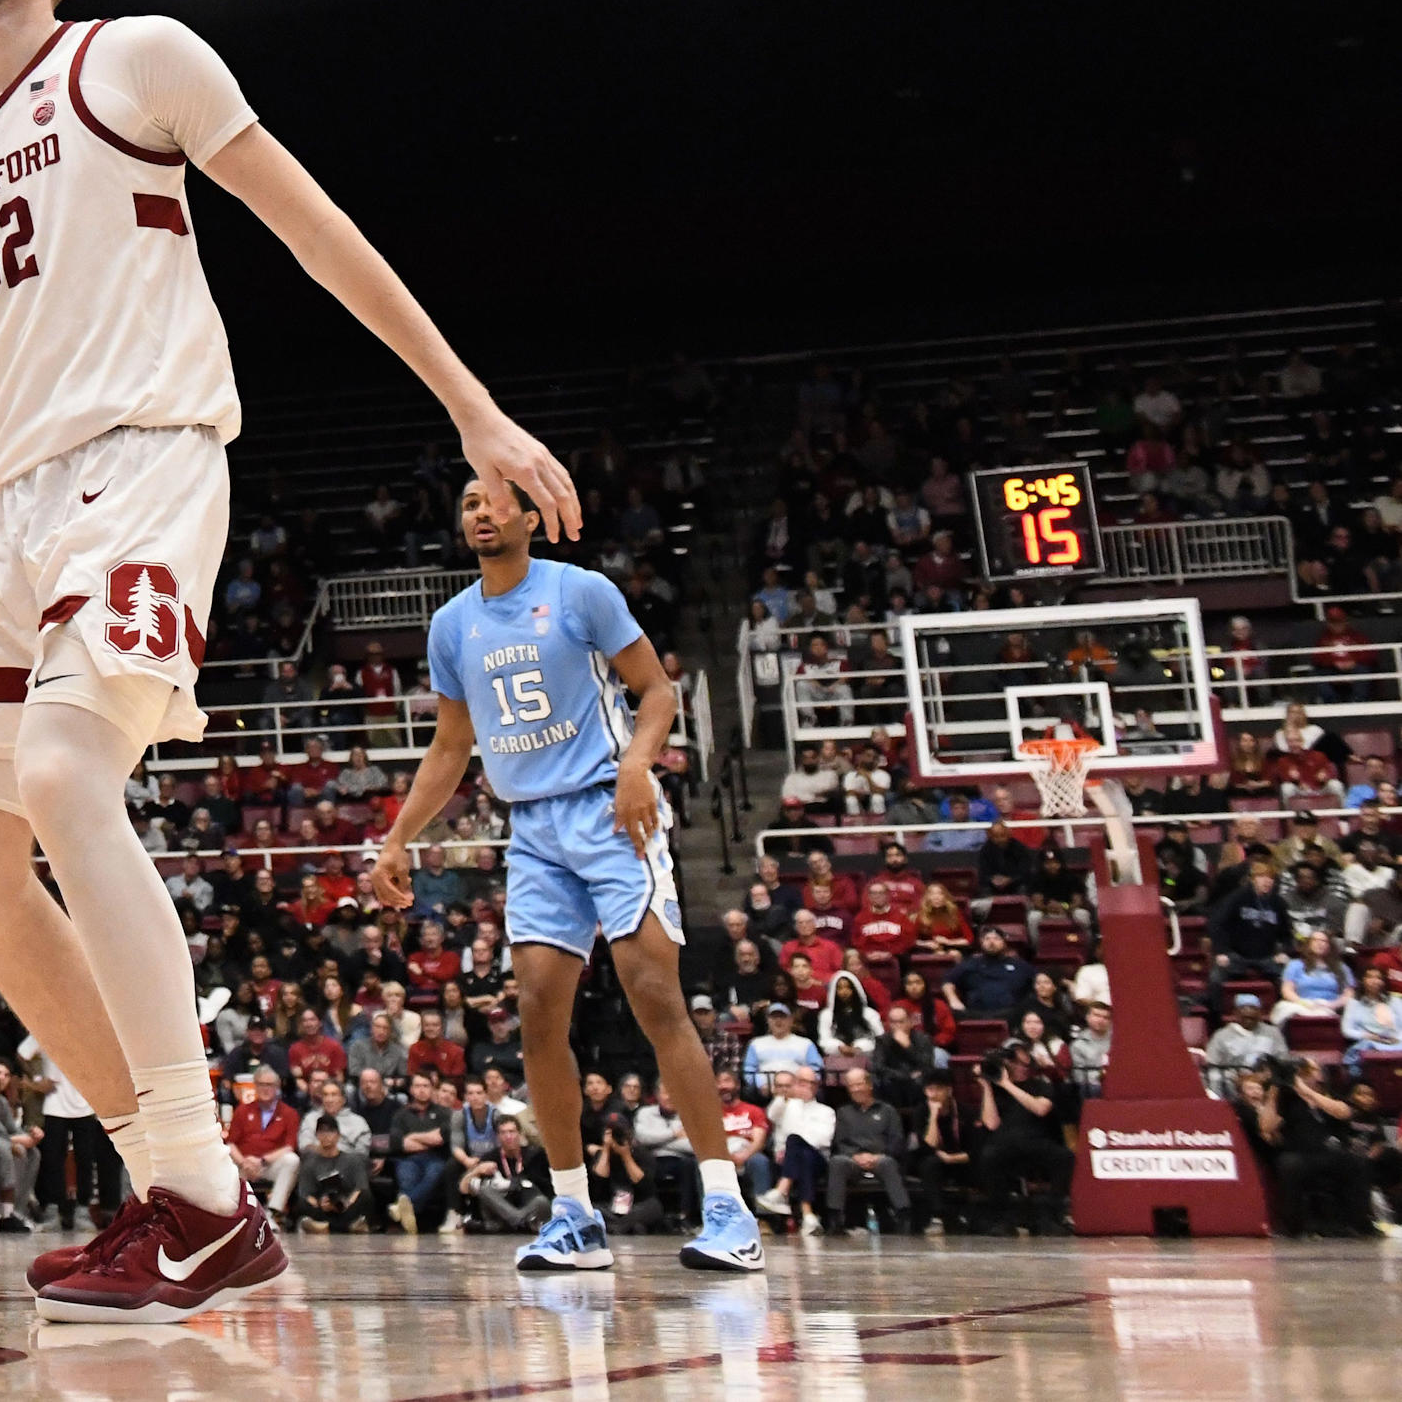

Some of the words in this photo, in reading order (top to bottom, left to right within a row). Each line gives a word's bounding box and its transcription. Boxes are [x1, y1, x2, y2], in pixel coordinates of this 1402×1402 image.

[1003, 473, 1081, 511] 6:45
[1021, 507, 1082, 565] 15
[483, 644, 540, 673] NORTH
[492, 669, 552, 727] 15
[489, 719, 579, 754] CAROLINA
[1100, 1157, 1163, 1173] CREDIT
[1168, 1157, 1228, 1173] UNION
